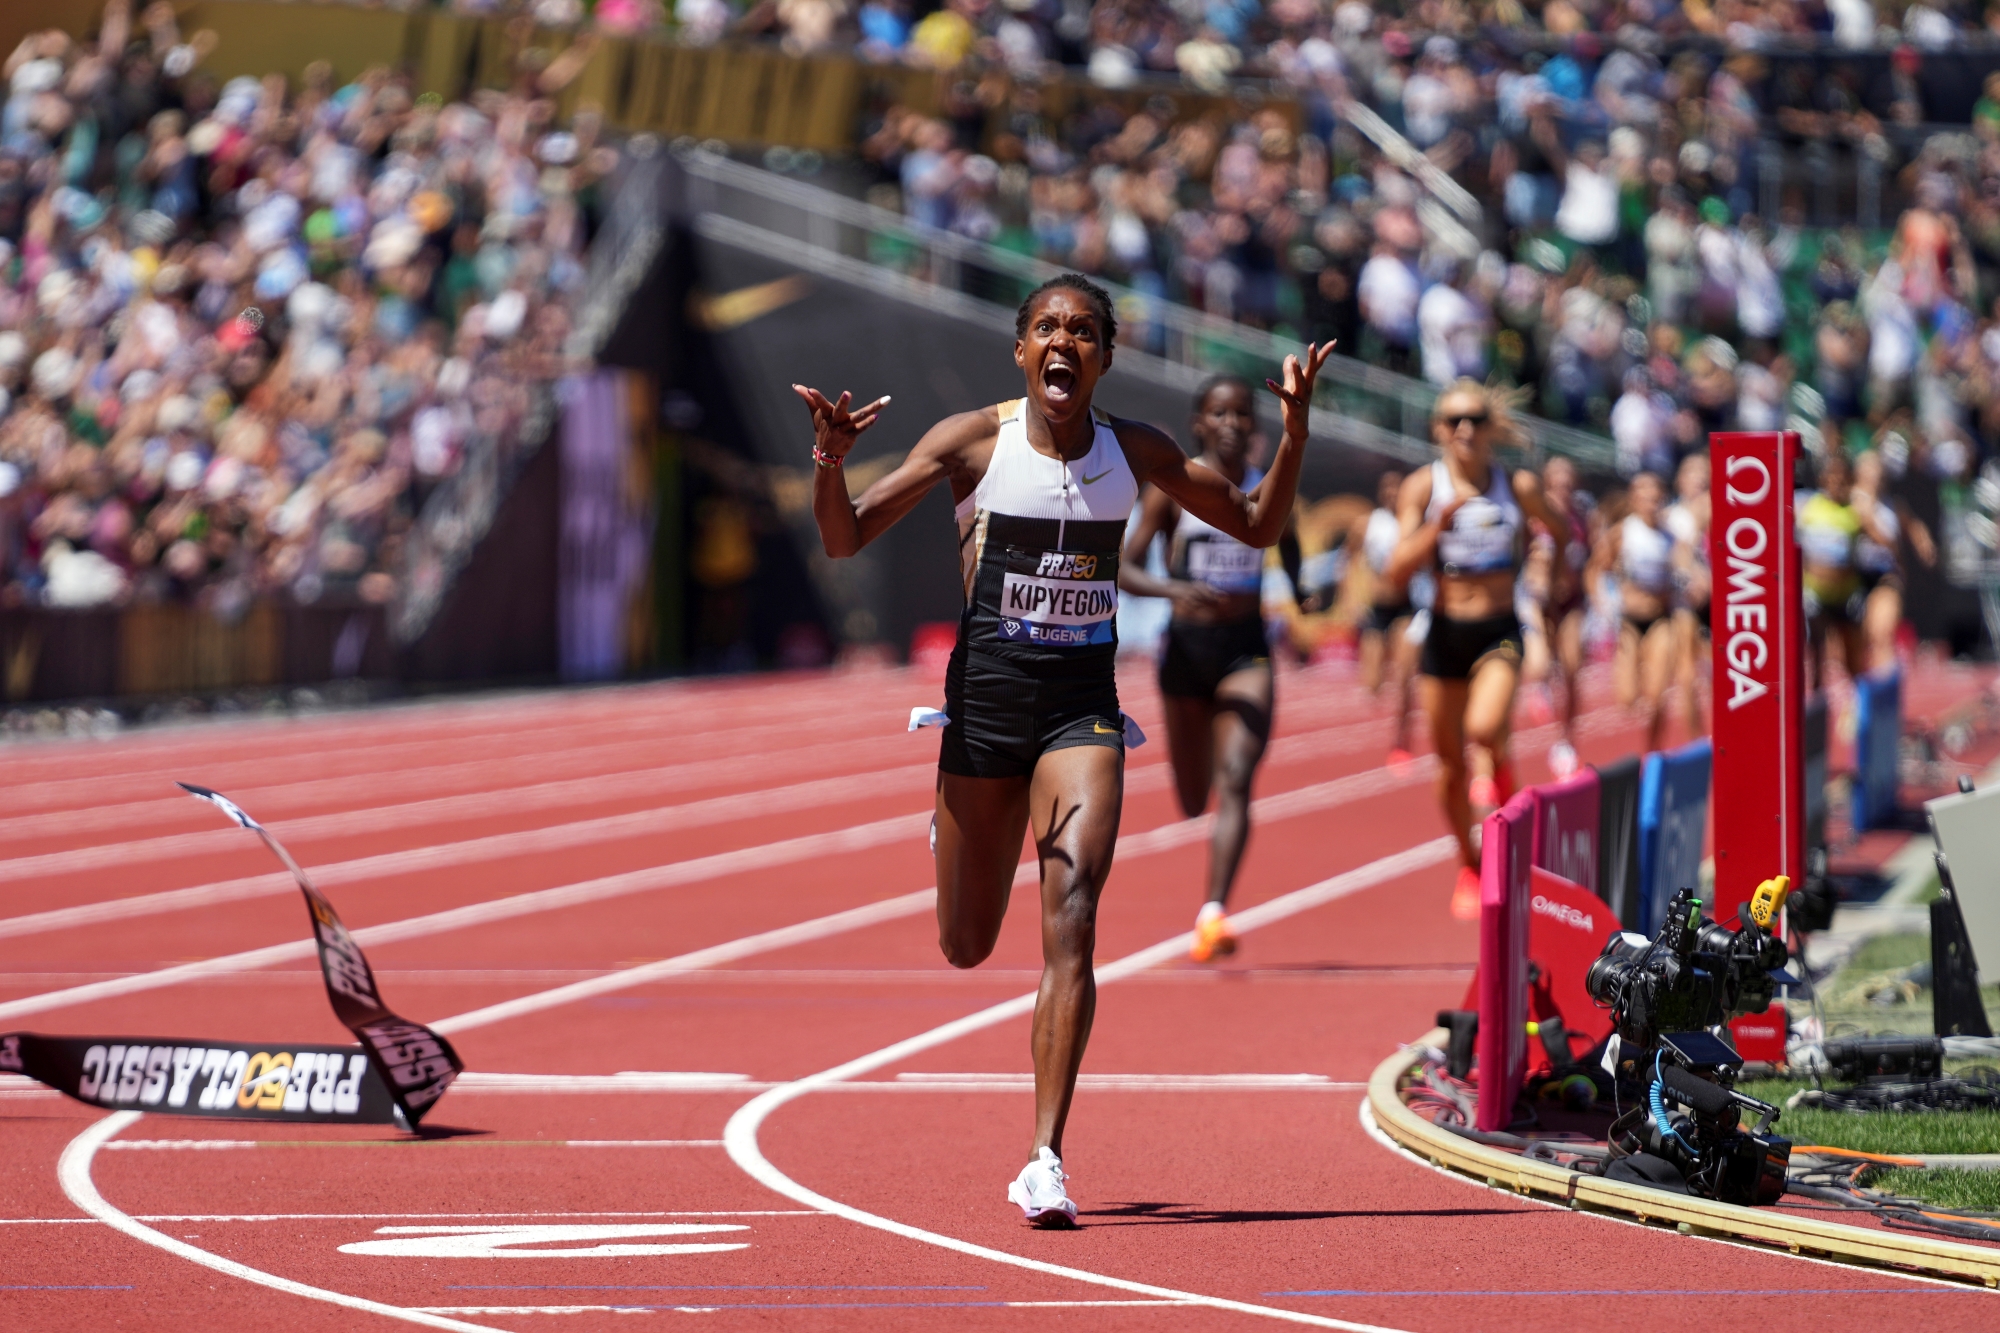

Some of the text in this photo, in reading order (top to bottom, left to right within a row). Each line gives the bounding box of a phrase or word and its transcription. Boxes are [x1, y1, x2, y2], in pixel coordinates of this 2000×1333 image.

[1009, 582, 1113, 616] KIPYEGON
[1725, 517, 1768, 711] OMEGA
[1029, 626, 1087, 642] EUGENE
[1531, 895, 1594, 934] OMEGA
